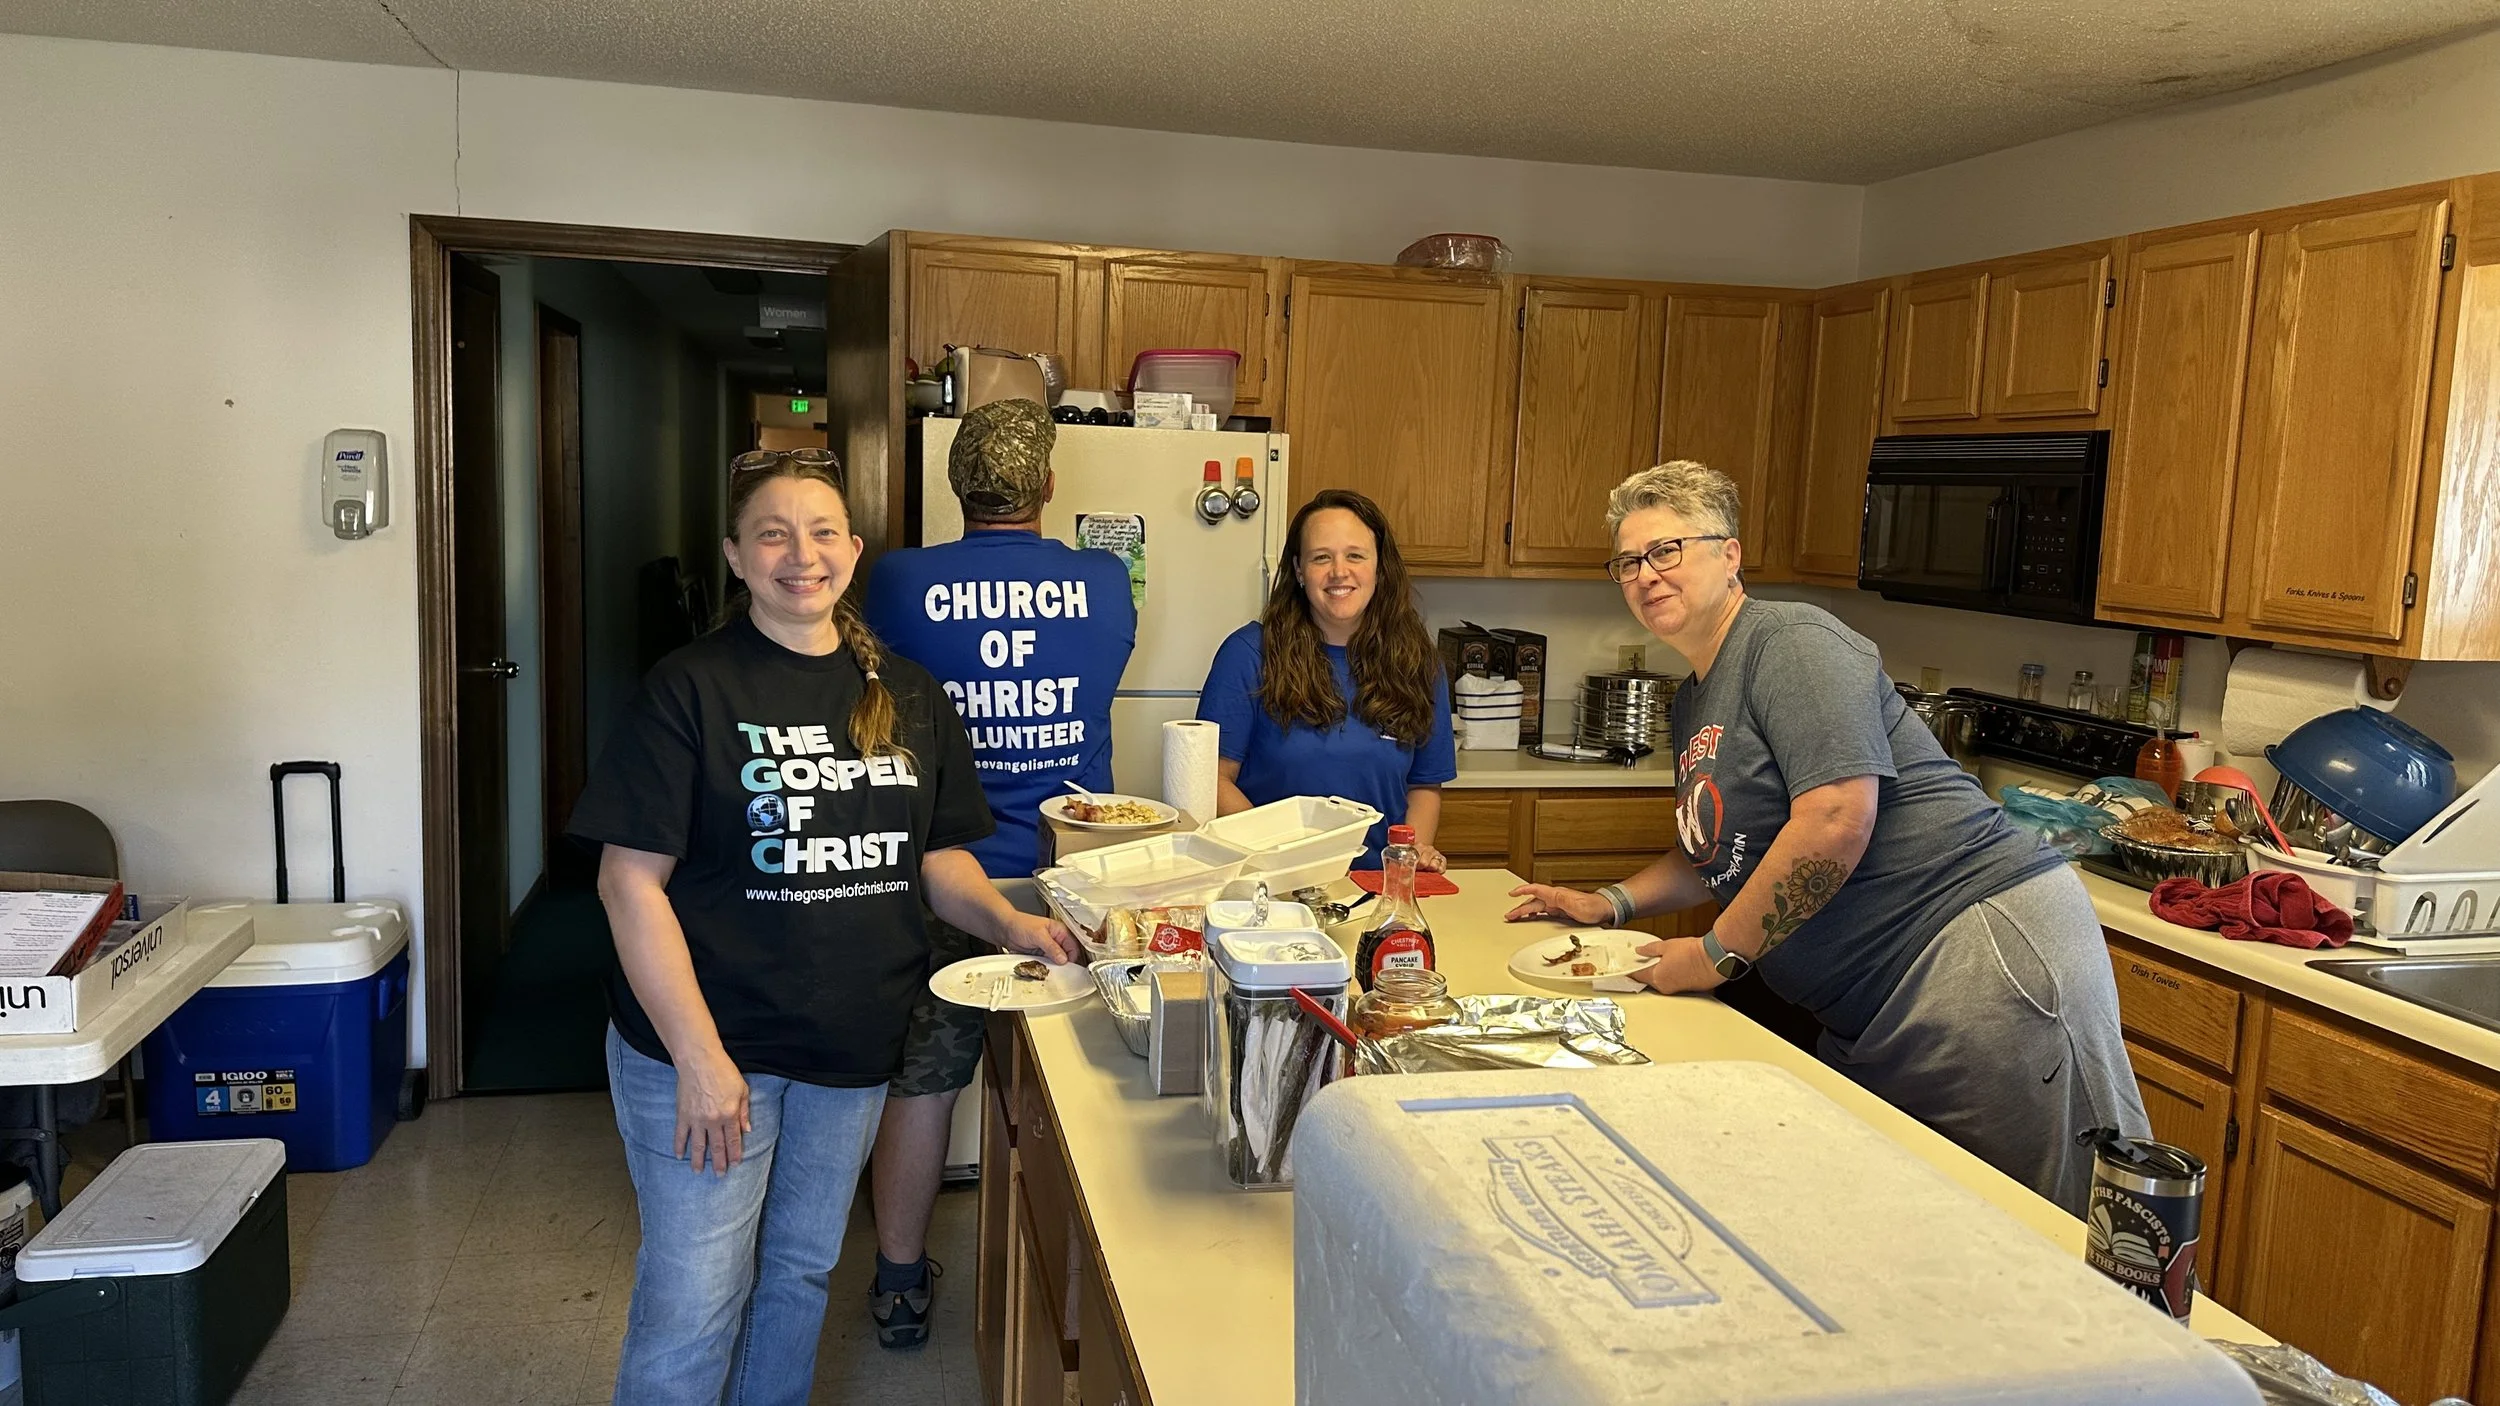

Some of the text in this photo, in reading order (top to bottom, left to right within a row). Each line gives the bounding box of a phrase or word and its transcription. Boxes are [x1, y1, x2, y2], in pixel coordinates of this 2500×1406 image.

[764, 306, 807, 319] Women
[792, 400, 809, 412] EXIT
[925, 580, 1089, 622] CHURCH
[2286, 587, 2305, 597] Forks,
[2307, 589, 2330, 599] Knives
[2338, 592, 2366, 602] Spoons
[980, 630, 1036, 668] OF
[943, 677, 1080, 718] CHRIST
[738, 722, 835, 756] THE
[965, 720, 1085, 749] LUNTEER
[741, 756, 919, 793] GOSPEL
[974, 753, 1080, 773] sevangelism.org
[747, 793, 815, 835] OF
[751, 832, 909, 874] CHRIST
[746, 880, 909, 904] www.thegospelofchrist.com
[111, 925, 163, 990] universal
[2131, 964, 2181, 990] Dish Towels
[222, 1071, 268, 1081] IGLOO
[266, 1086, 283, 1095] 60
[205, 1090, 221, 1106] 4
[1514, 1140, 1680, 1292] OMAHA STEAKS
[2095, 1186, 2171, 1245] THE FASCISTS
[2095, 1254, 2115, 1271] THE
[2116, 1262, 2161, 1284] BOOKS
